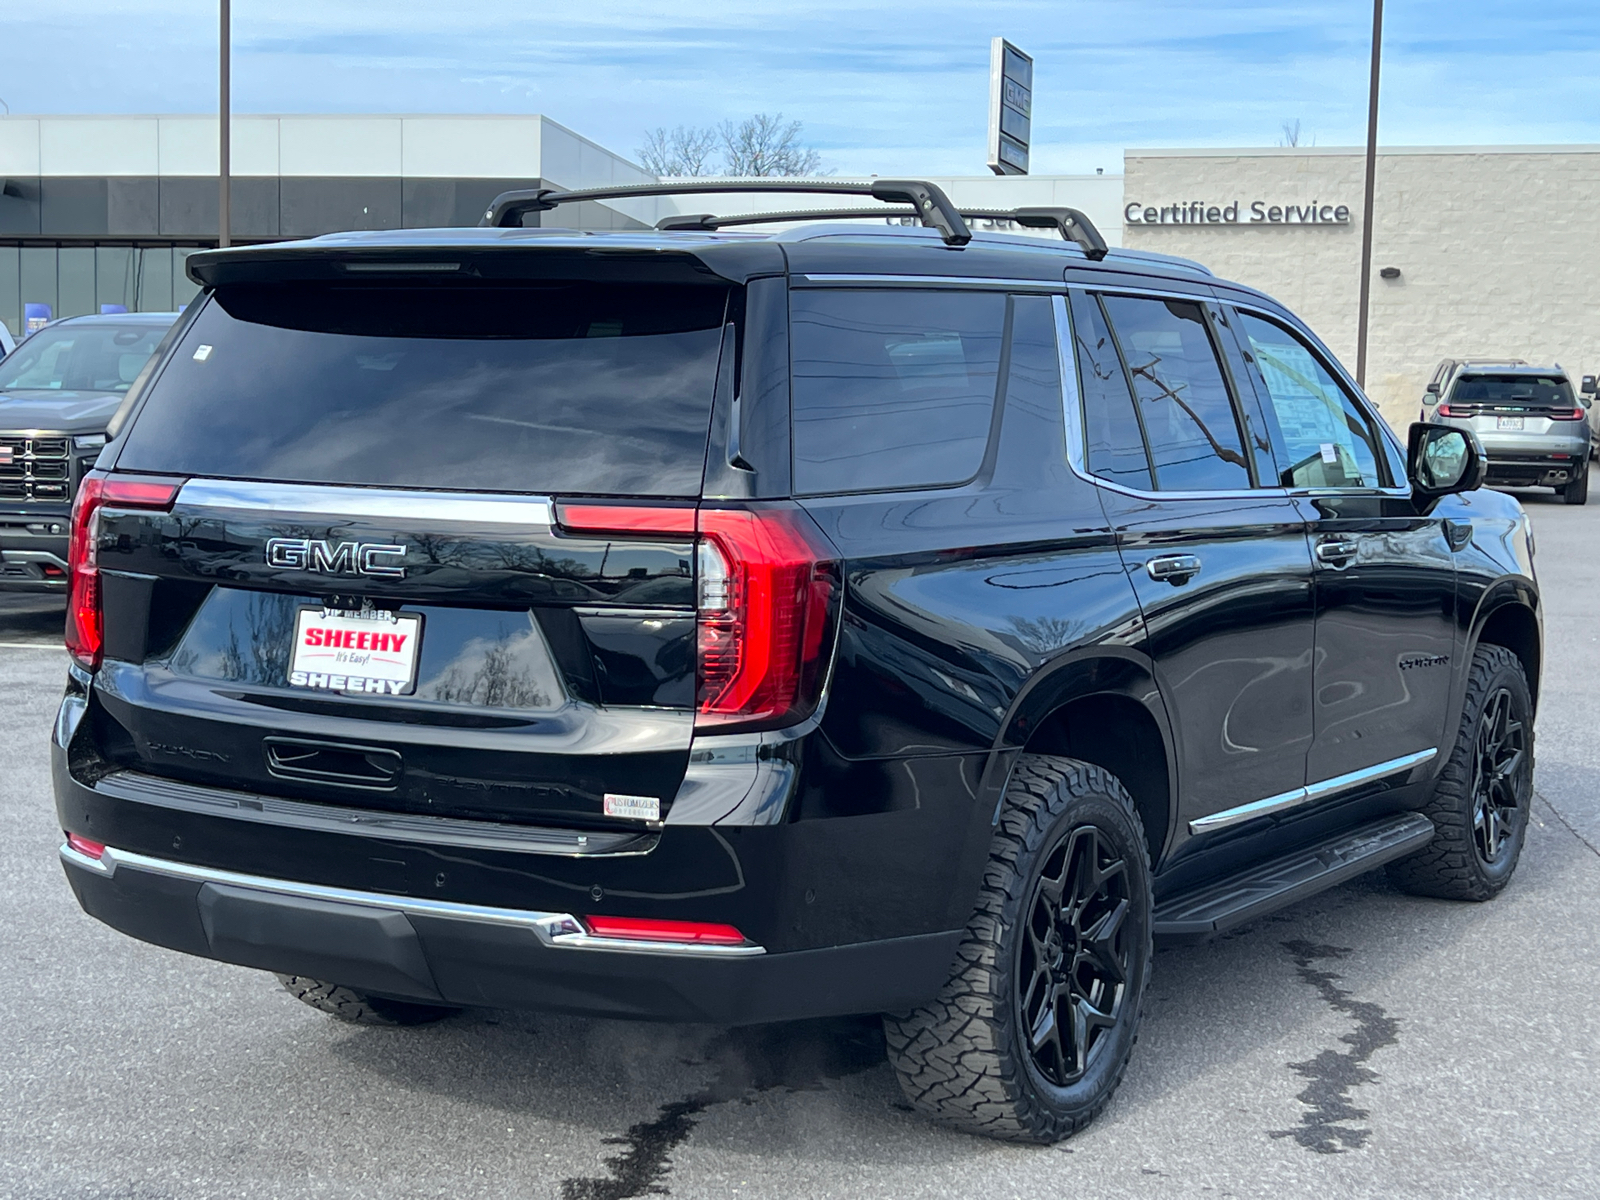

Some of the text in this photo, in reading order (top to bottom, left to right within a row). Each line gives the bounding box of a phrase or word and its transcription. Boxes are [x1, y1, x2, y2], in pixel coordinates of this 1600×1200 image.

[1124, 200, 1349, 223] Certified Service
[266, 537, 407, 578] GMC
[323, 607, 392, 621] VIP MEMBER
[304, 627, 408, 653] SHEEHY
[335, 651, 371, 666] It's Easy!
[290, 671, 407, 695] SHEEHY
